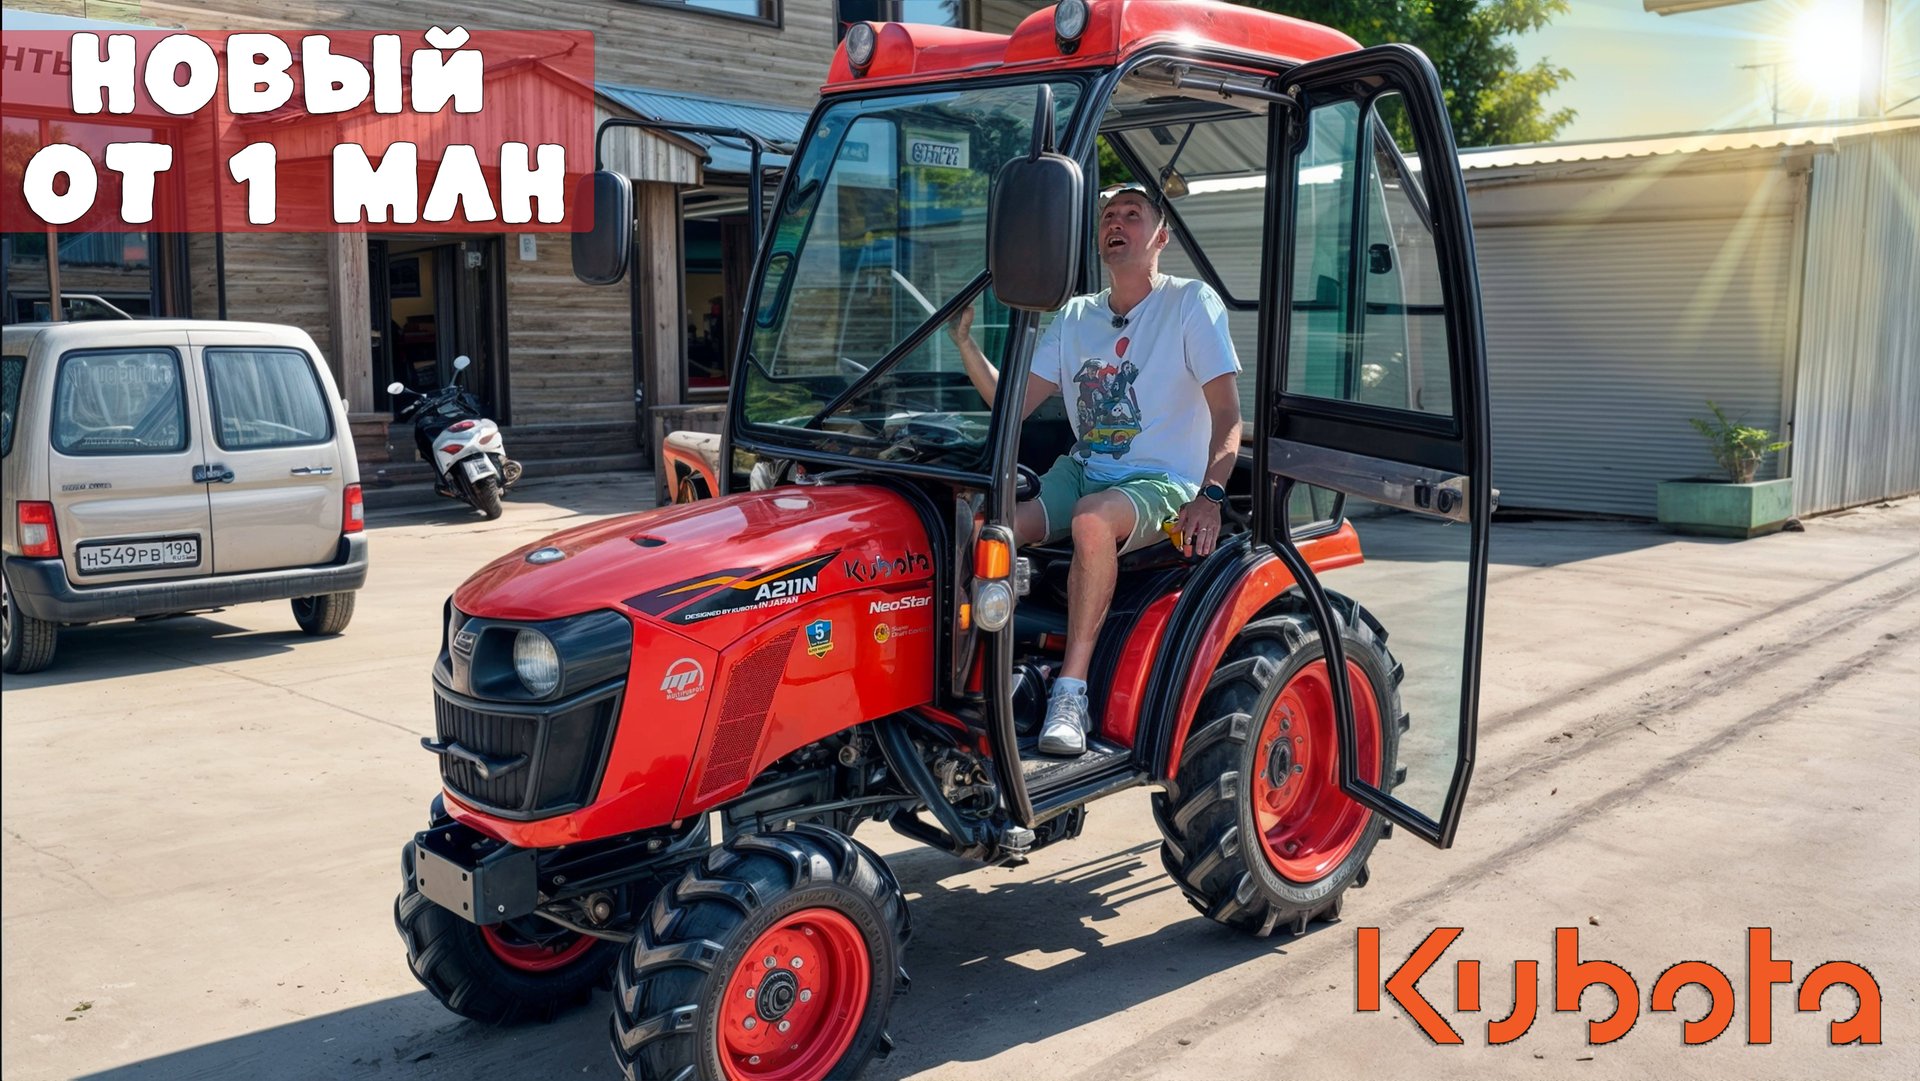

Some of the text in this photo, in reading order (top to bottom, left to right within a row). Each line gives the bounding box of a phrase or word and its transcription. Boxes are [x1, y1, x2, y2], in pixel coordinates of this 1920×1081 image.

[166, 542, 192, 555] 190
[843, 550, 930, 582] Kubota
[754, 576, 817, 602] A211N
[684, 609, 722, 620] DESIGNED
[731, 603, 758, 614] KUBOTA
[758, 601, 768, 609] IN
[768, 596, 799, 608] JAPAN
[869, 596, 931, 614] NeoStar
[815, 623, 825, 640] 5
